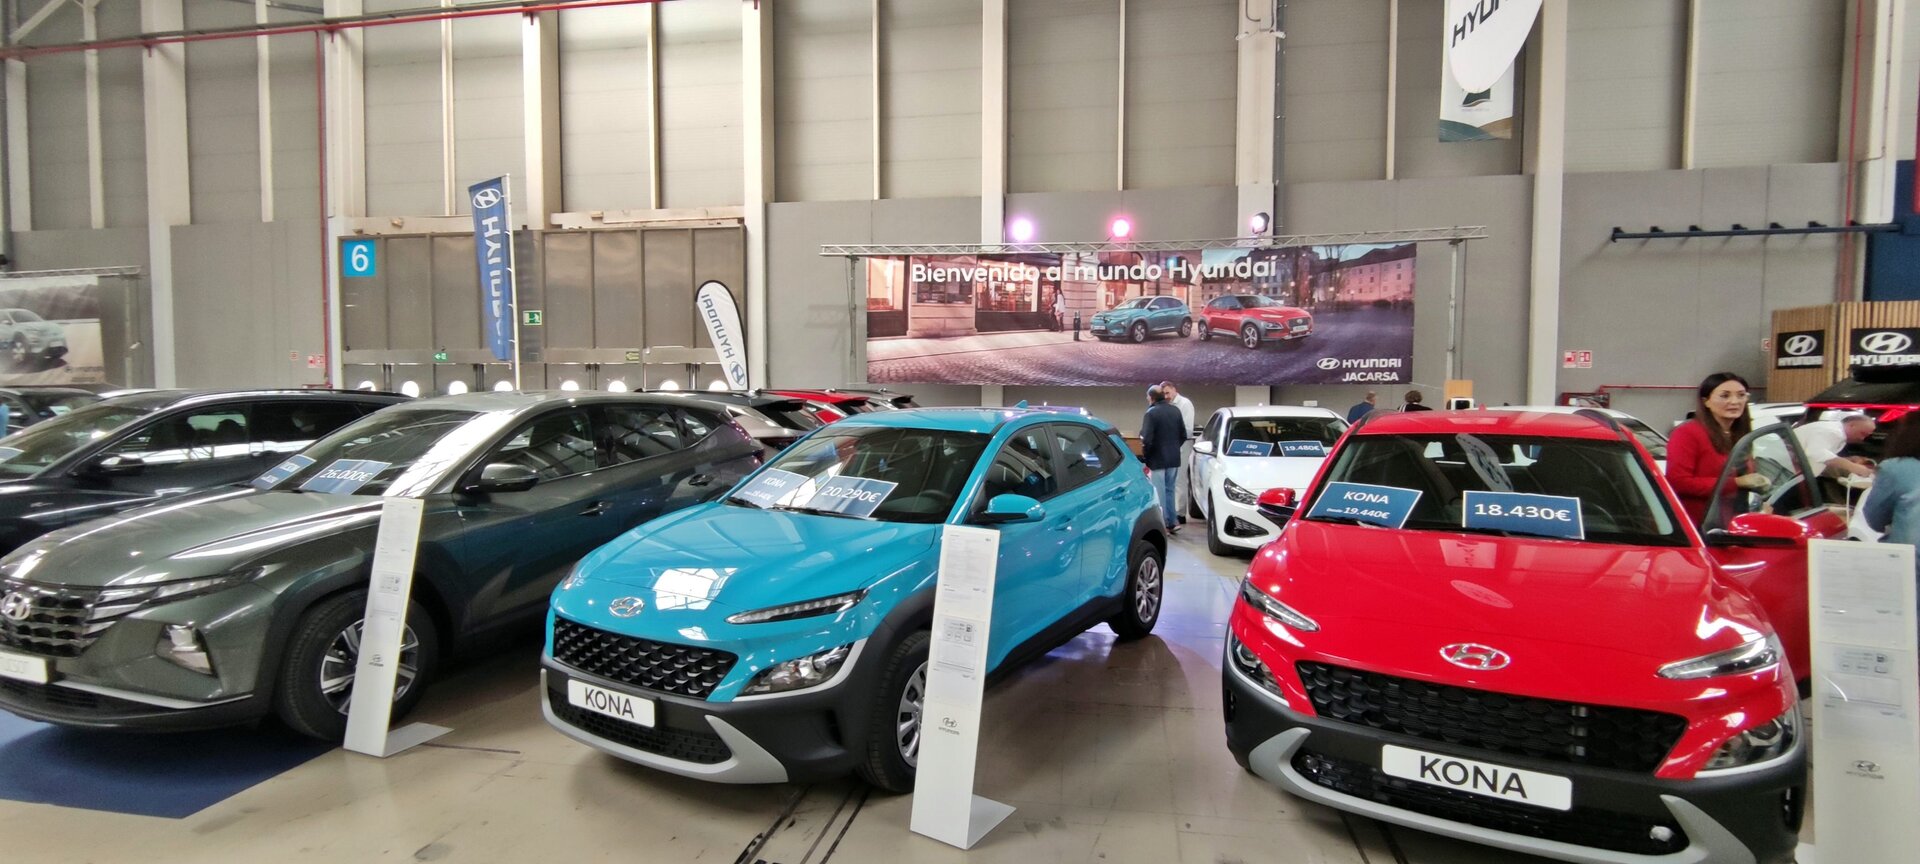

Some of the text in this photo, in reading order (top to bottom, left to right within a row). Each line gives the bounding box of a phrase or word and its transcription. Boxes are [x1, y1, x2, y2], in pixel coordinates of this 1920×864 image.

[351, 244, 369, 272] 6
[912, 262, 1040, 283] Bienvenido
[1075, 260, 1162, 281] mundo
[1169, 256, 1277, 284] Hyundai
[1342, 358, 1402, 369] HYUNDAI
[1849, 354, 1920, 367] HYUNDA
[1342, 371, 1399, 382] JACARSA
[319, 469, 373, 482] 26.000€
[820, 486, 882, 503] 20.290€
[1343, 491, 1390, 504] KONA
[1343, 506, 1391, 519] 19.440€
[1474, 503, 1572, 522] 18.430€
[585, 687, 635, 719] KONA
[1420, 755, 1528, 799] KONA
